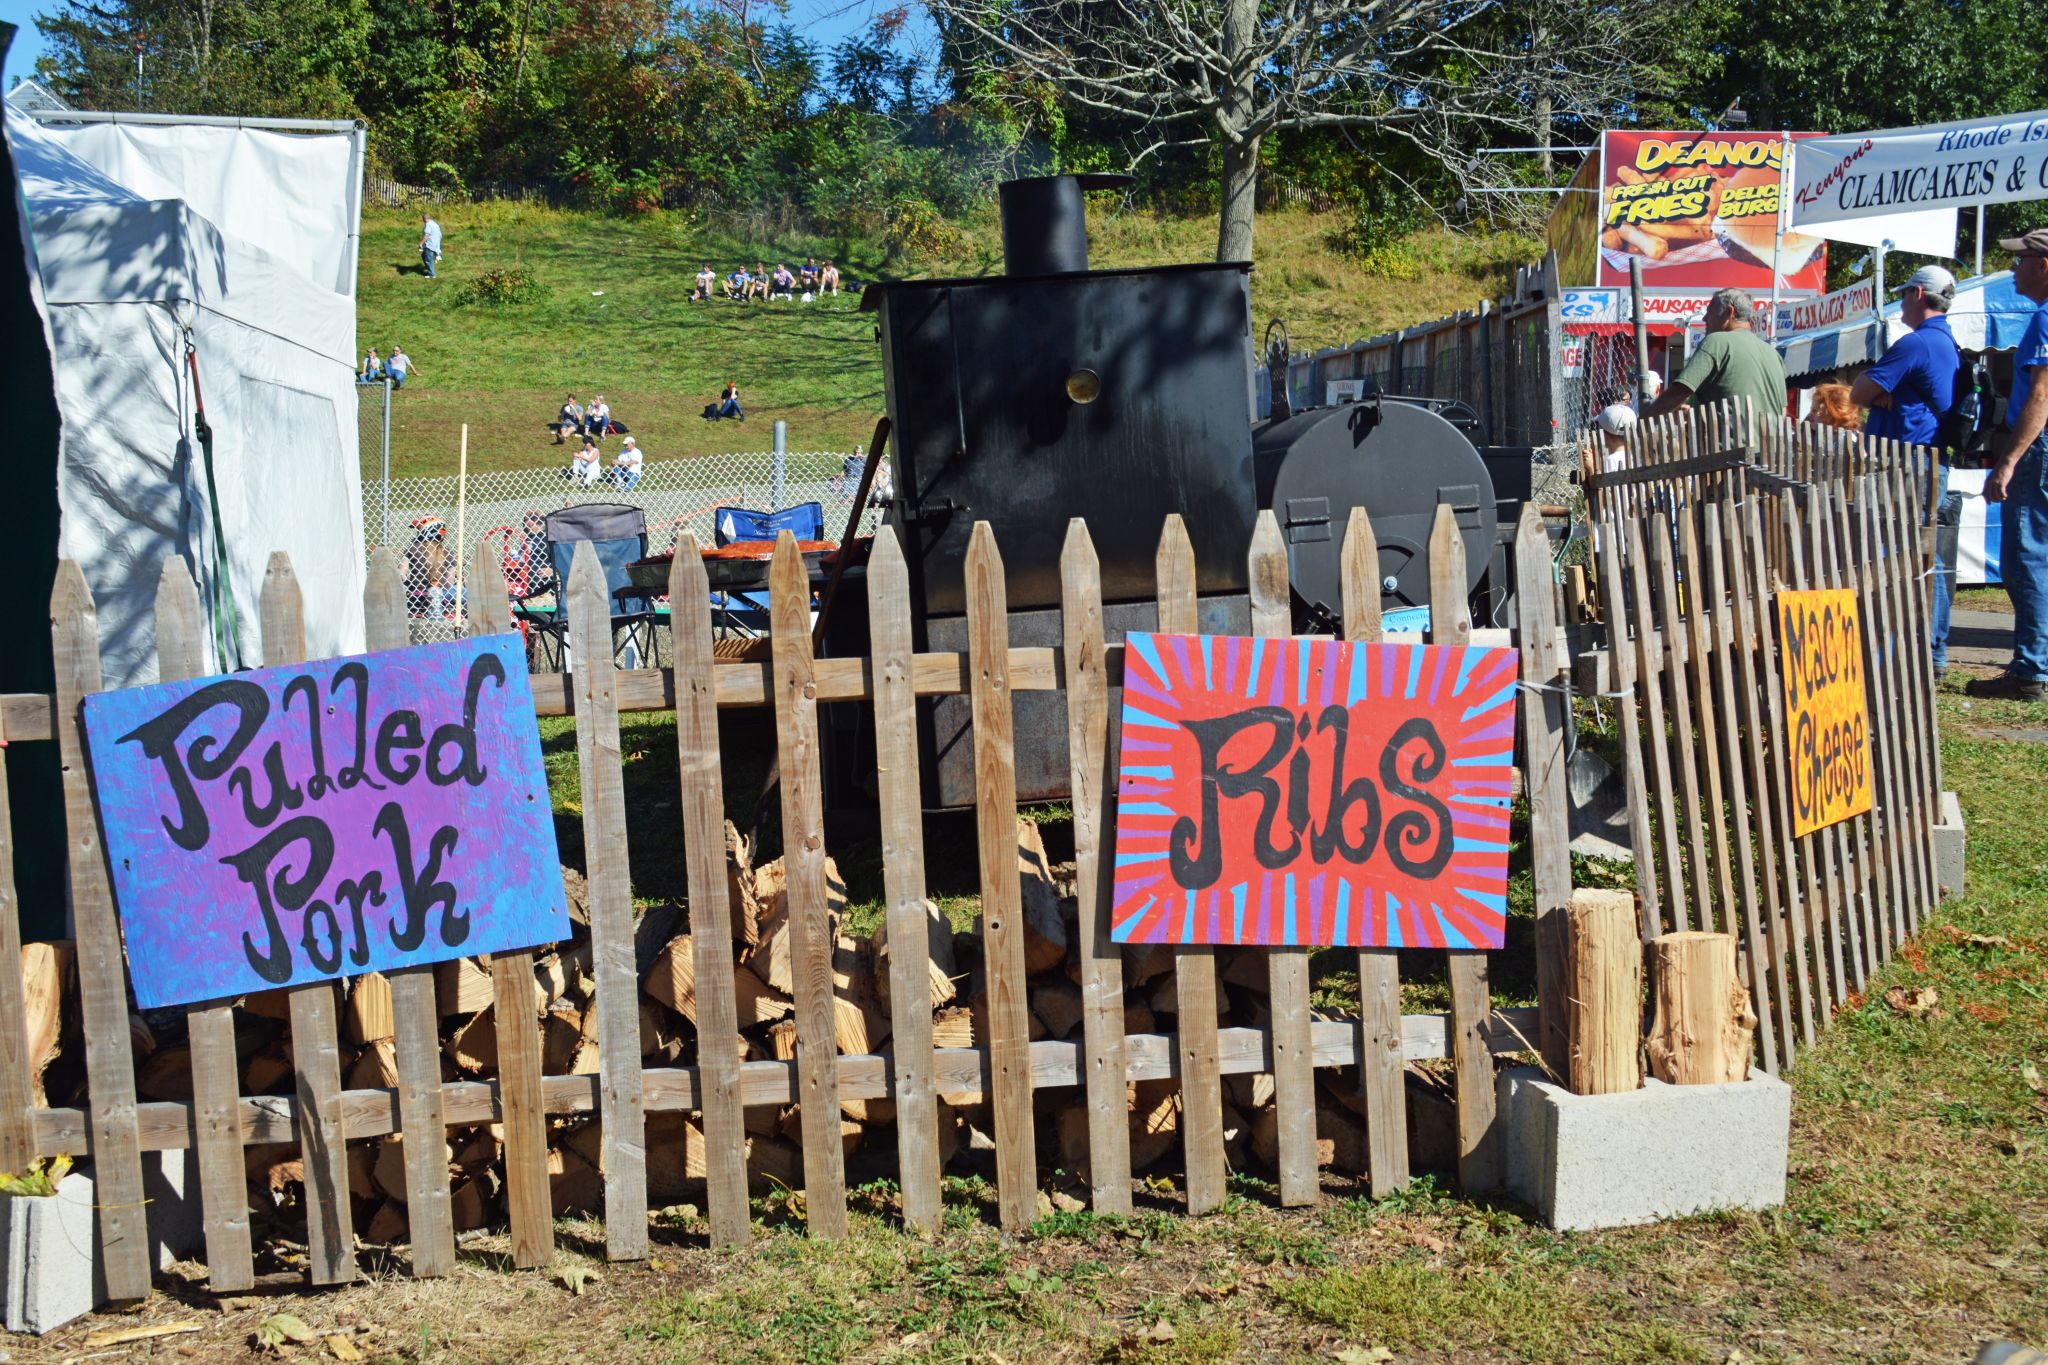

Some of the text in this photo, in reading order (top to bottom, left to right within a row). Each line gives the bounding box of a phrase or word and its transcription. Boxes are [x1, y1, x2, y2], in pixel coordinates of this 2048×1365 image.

[1936, 123, 2011, 152] Rhode
[1635, 139, 1790, 172] DEANO'S
[1611, 174, 1711, 200] FRESH CUT
[1796, 137, 1873, 212] Kenyon's
[1839, 158, 2000, 210] CLAMCAKES
[2006, 156, 2027, 192] &
[1606, 192, 1705, 225] FRIES
[1717, 197, 1780, 218] BURG
[1720, 183, 1781, 203] DELICI
[115, 652, 506, 852] Pulled
[1795, 710, 1864, 827] Cheese
[218, 801, 471, 985] Pork
